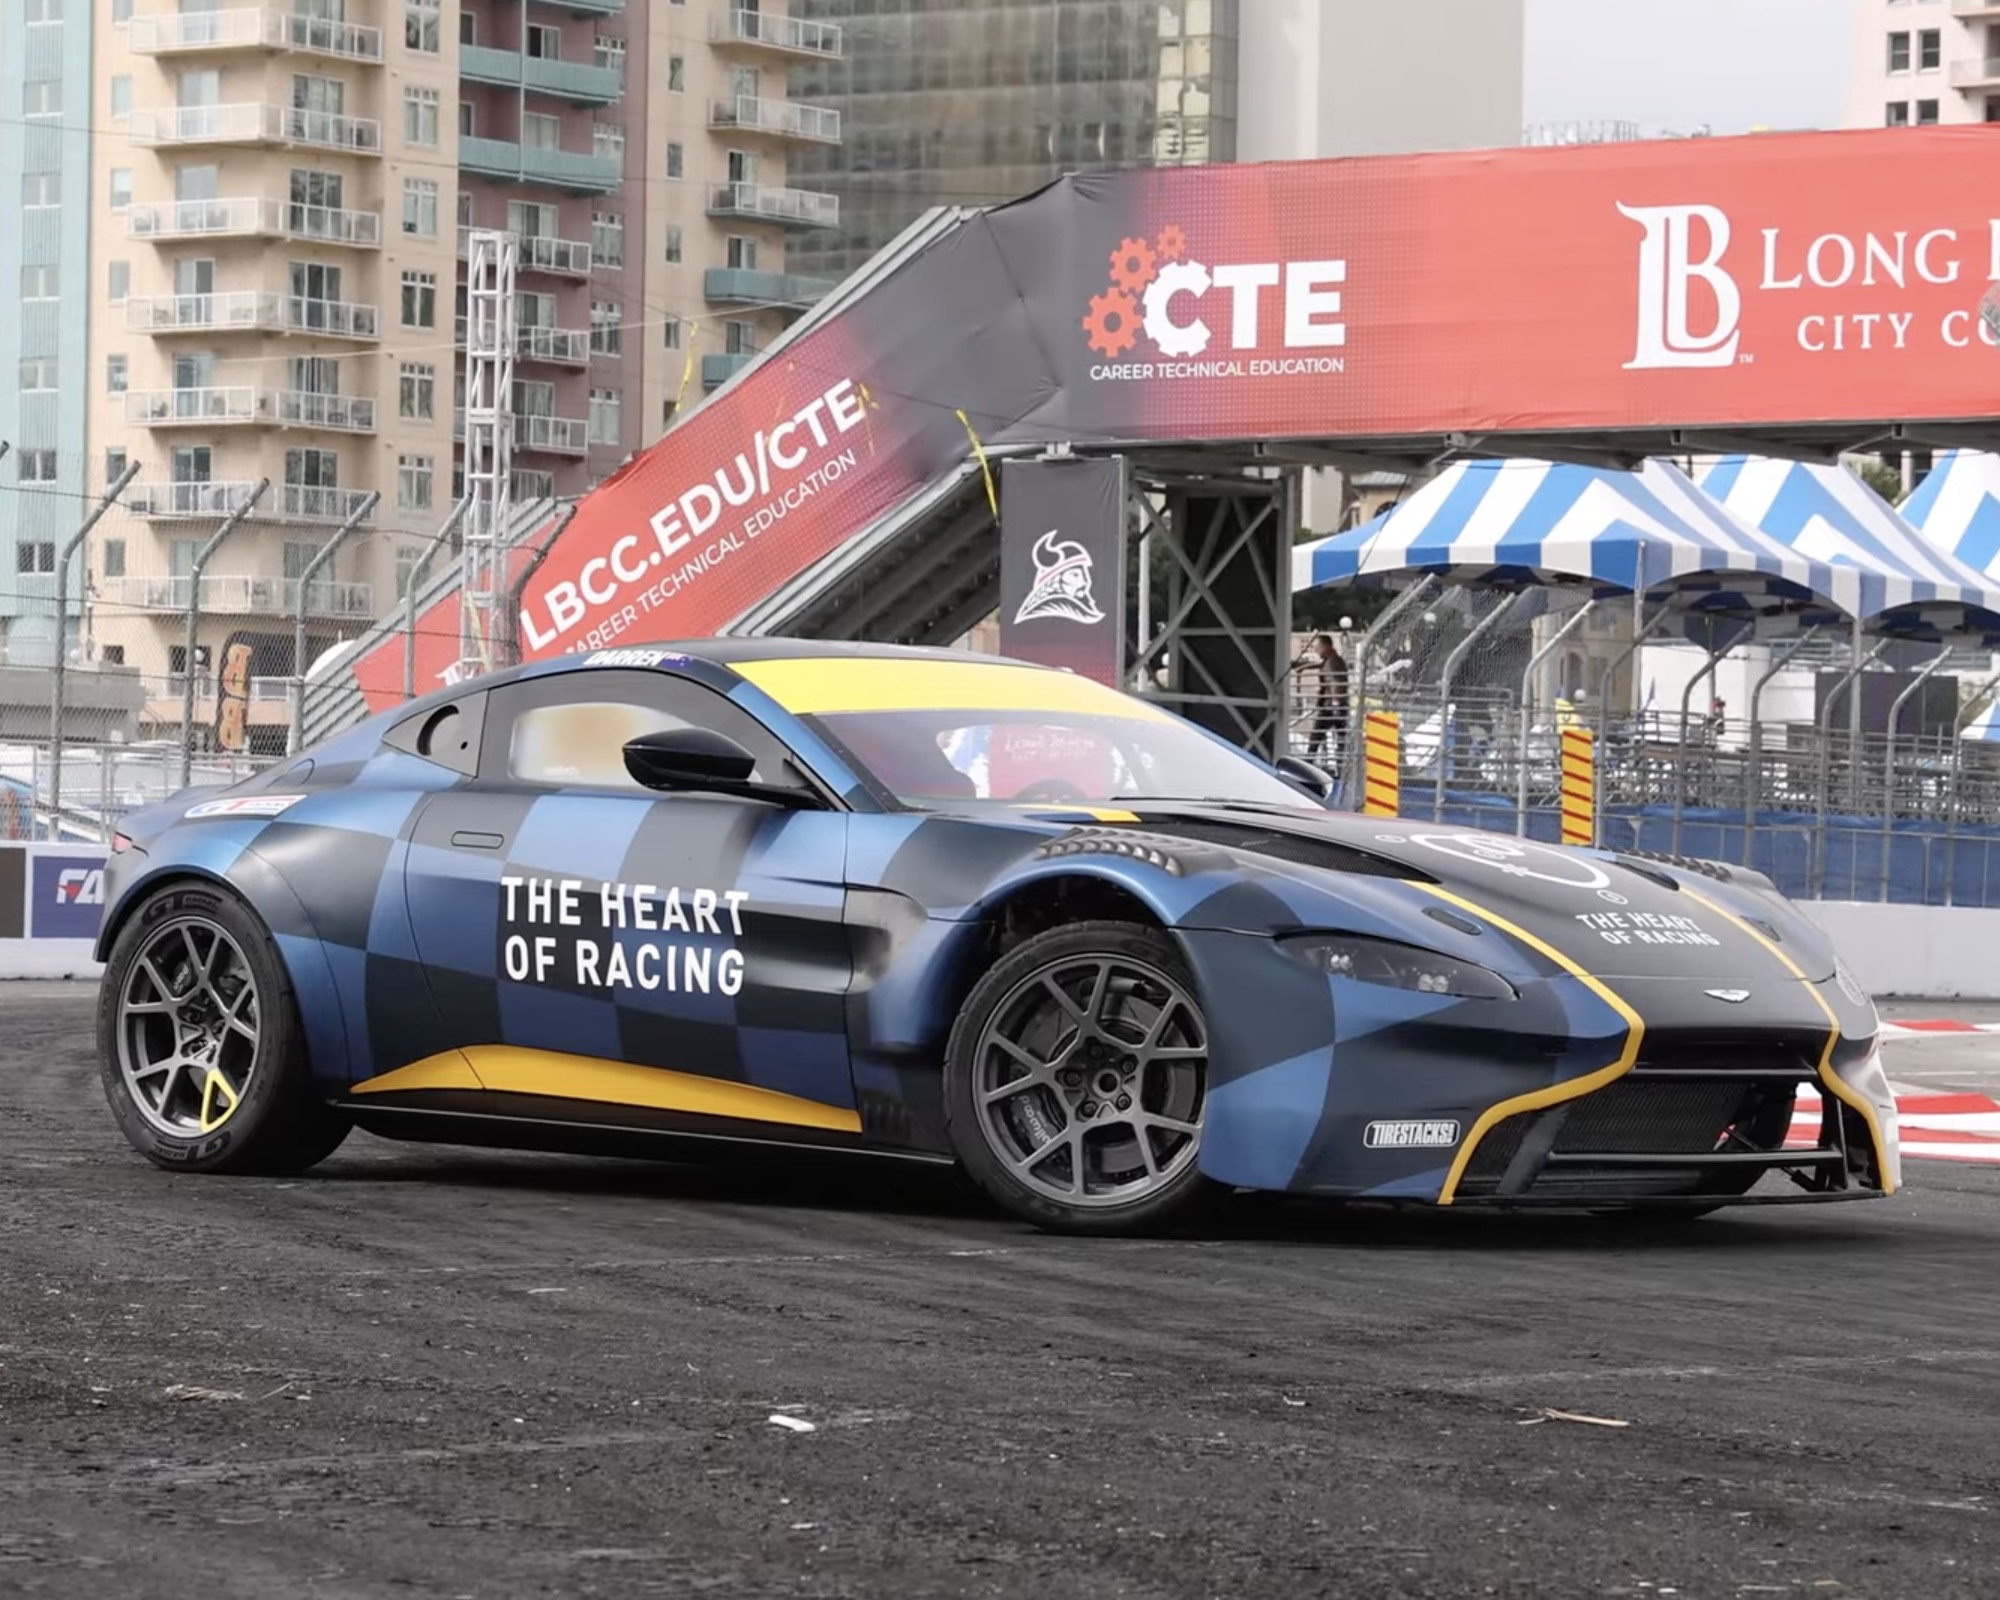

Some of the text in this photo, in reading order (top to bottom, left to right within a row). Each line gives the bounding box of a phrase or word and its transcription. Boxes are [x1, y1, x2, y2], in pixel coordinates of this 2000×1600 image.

[1760, 228, 1960, 289] LONG
[1142, 259, 1346, 358] CTE
[1797, 312, 1913, 351] CITY
[1090, 357, 1346, 381] CAREER TECHNICAL EDUCATION
[519, 378, 867, 652] LBCC.EDU/CTE
[636, 531, 744, 613] TECHNICAL
[744, 448, 857, 539] EDUCATION
[501, 876, 749, 935] THE HEART
[1575, 912, 1702, 932] THE HEART
[505, 935, 745, 996] OF RACING
[1600, 930, 1720, 946] OF RACING
[1372, 1123, 1448, 1145] TIRESTACKS
